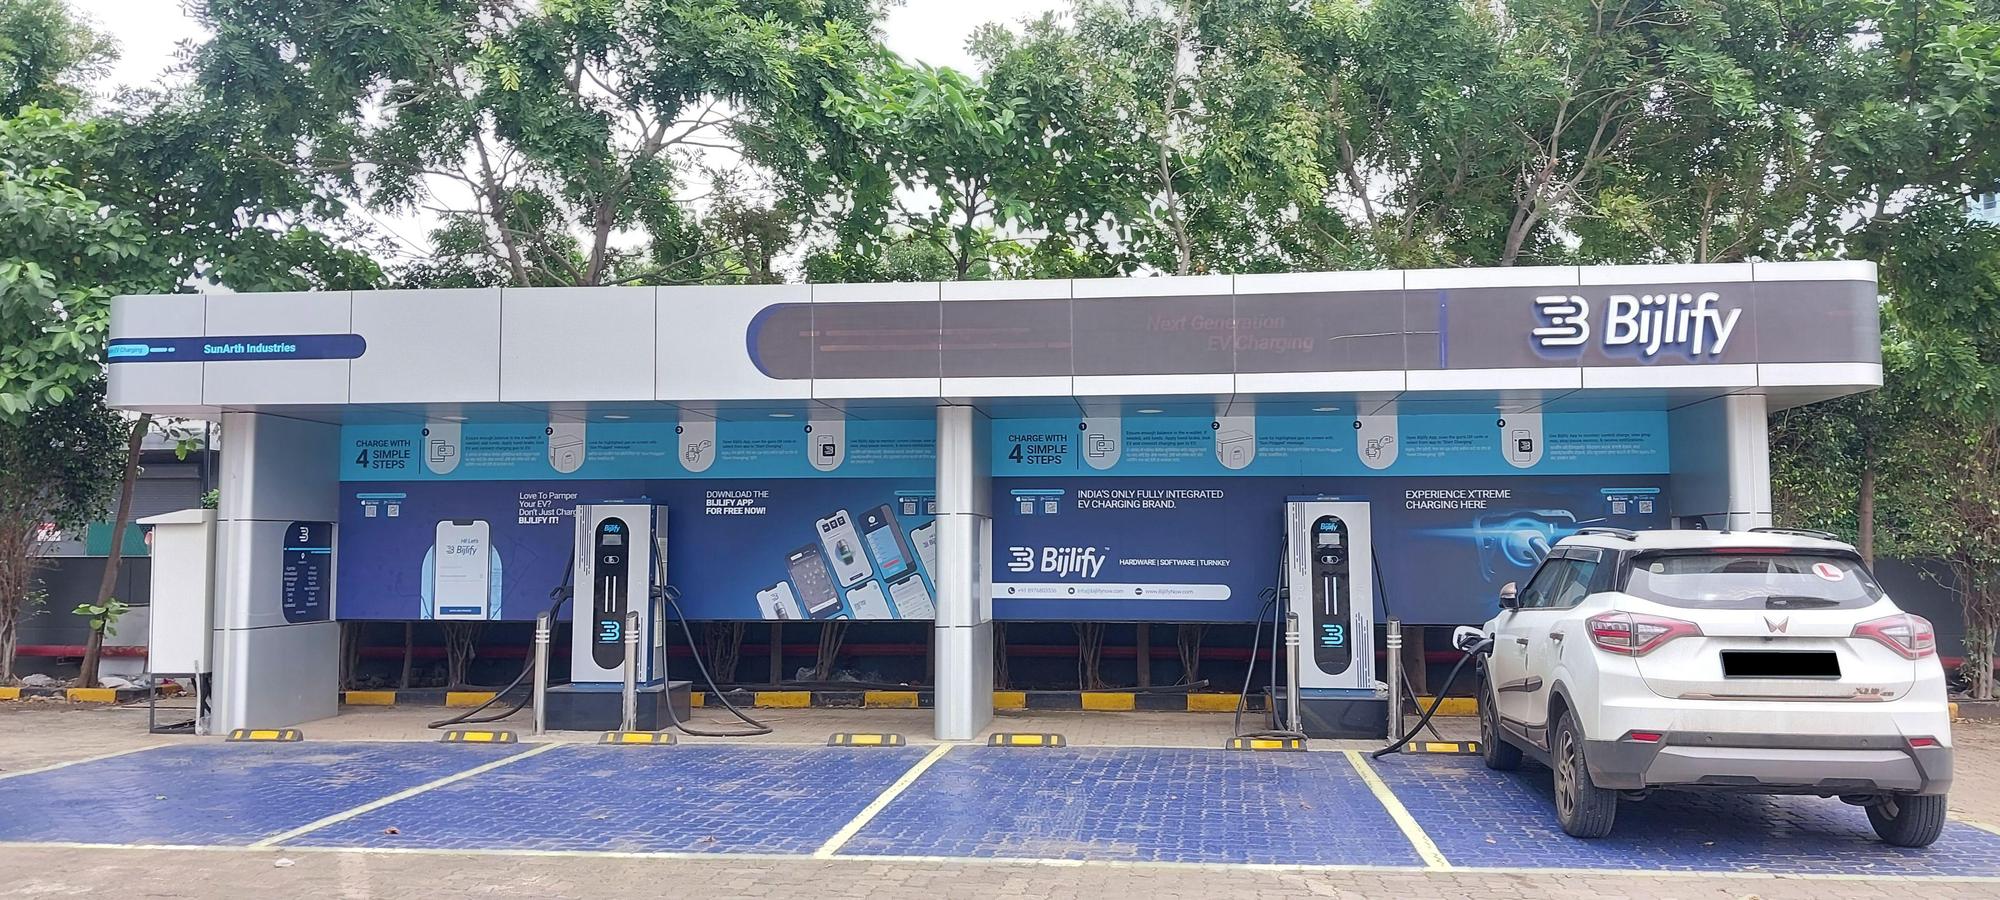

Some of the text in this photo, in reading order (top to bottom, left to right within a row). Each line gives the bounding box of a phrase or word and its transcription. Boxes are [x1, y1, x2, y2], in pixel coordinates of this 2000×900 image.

[1147, 313, 1285, 331] Next Generation
[1605, 292, 1743, 355] Bijlify
[203, 342, 296, 354] SunArth Industries
[1208, 336, 1314, 353] EV Charging
[1008, 434, 1067, 442] CHARGE WITH
[1008, 443, 1068, 463] 4 SIMPLE
[356, 449, 411, 468] 4 SIMPLE
[1027, 455, 1062, 464] STEPS
[372, 460, 405, 469] STEPS
[519, 492, 537, 500] Love
[549, 492, 578, 501] Pamper
[706, 490, 769, 498] DOWNLOAD THE
[1077, 490, 1224, 498] INDIA'S ONLY FULLY INTEGRATED
[1405, 490, 1511, 499] EXPERIENCE X'TREME
[1078, 500, 1177, 508] EV CHARGING BRAND.
[1405, 500, 1487, 509] CHARGING HERE
[538, 508, 555, 516] Just
[456, 545, 477, 555] Bijlify
[1040, 547, 1106, 578] Bijlify
[1817, 565, 1841, 578] L
